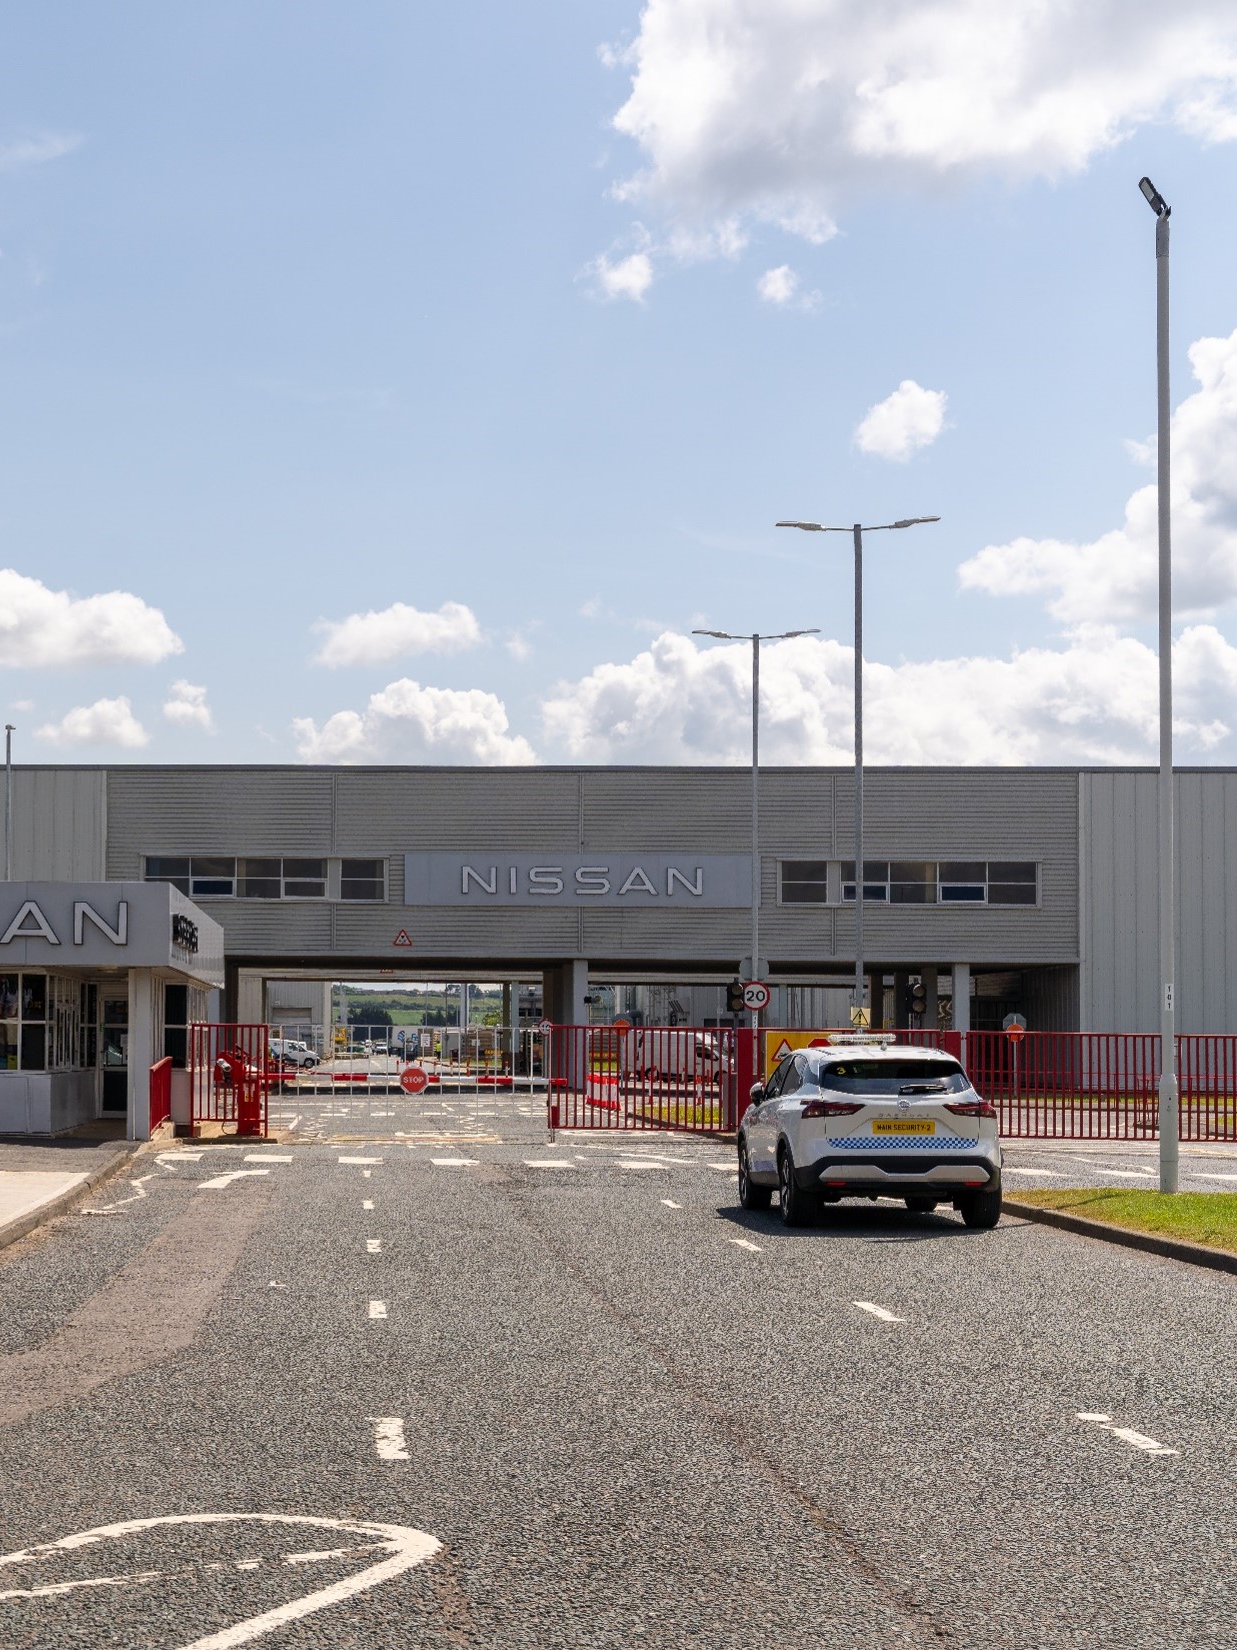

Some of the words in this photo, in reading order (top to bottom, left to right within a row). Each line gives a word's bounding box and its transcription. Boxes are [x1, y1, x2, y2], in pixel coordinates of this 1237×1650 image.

[460, 865, 704, 896] NISSAN
[746, 990, 766, 1002] 20
[402, 1076, 424, 1084] STOP
[894, 1124, 931, 1132] SECURITY-2
